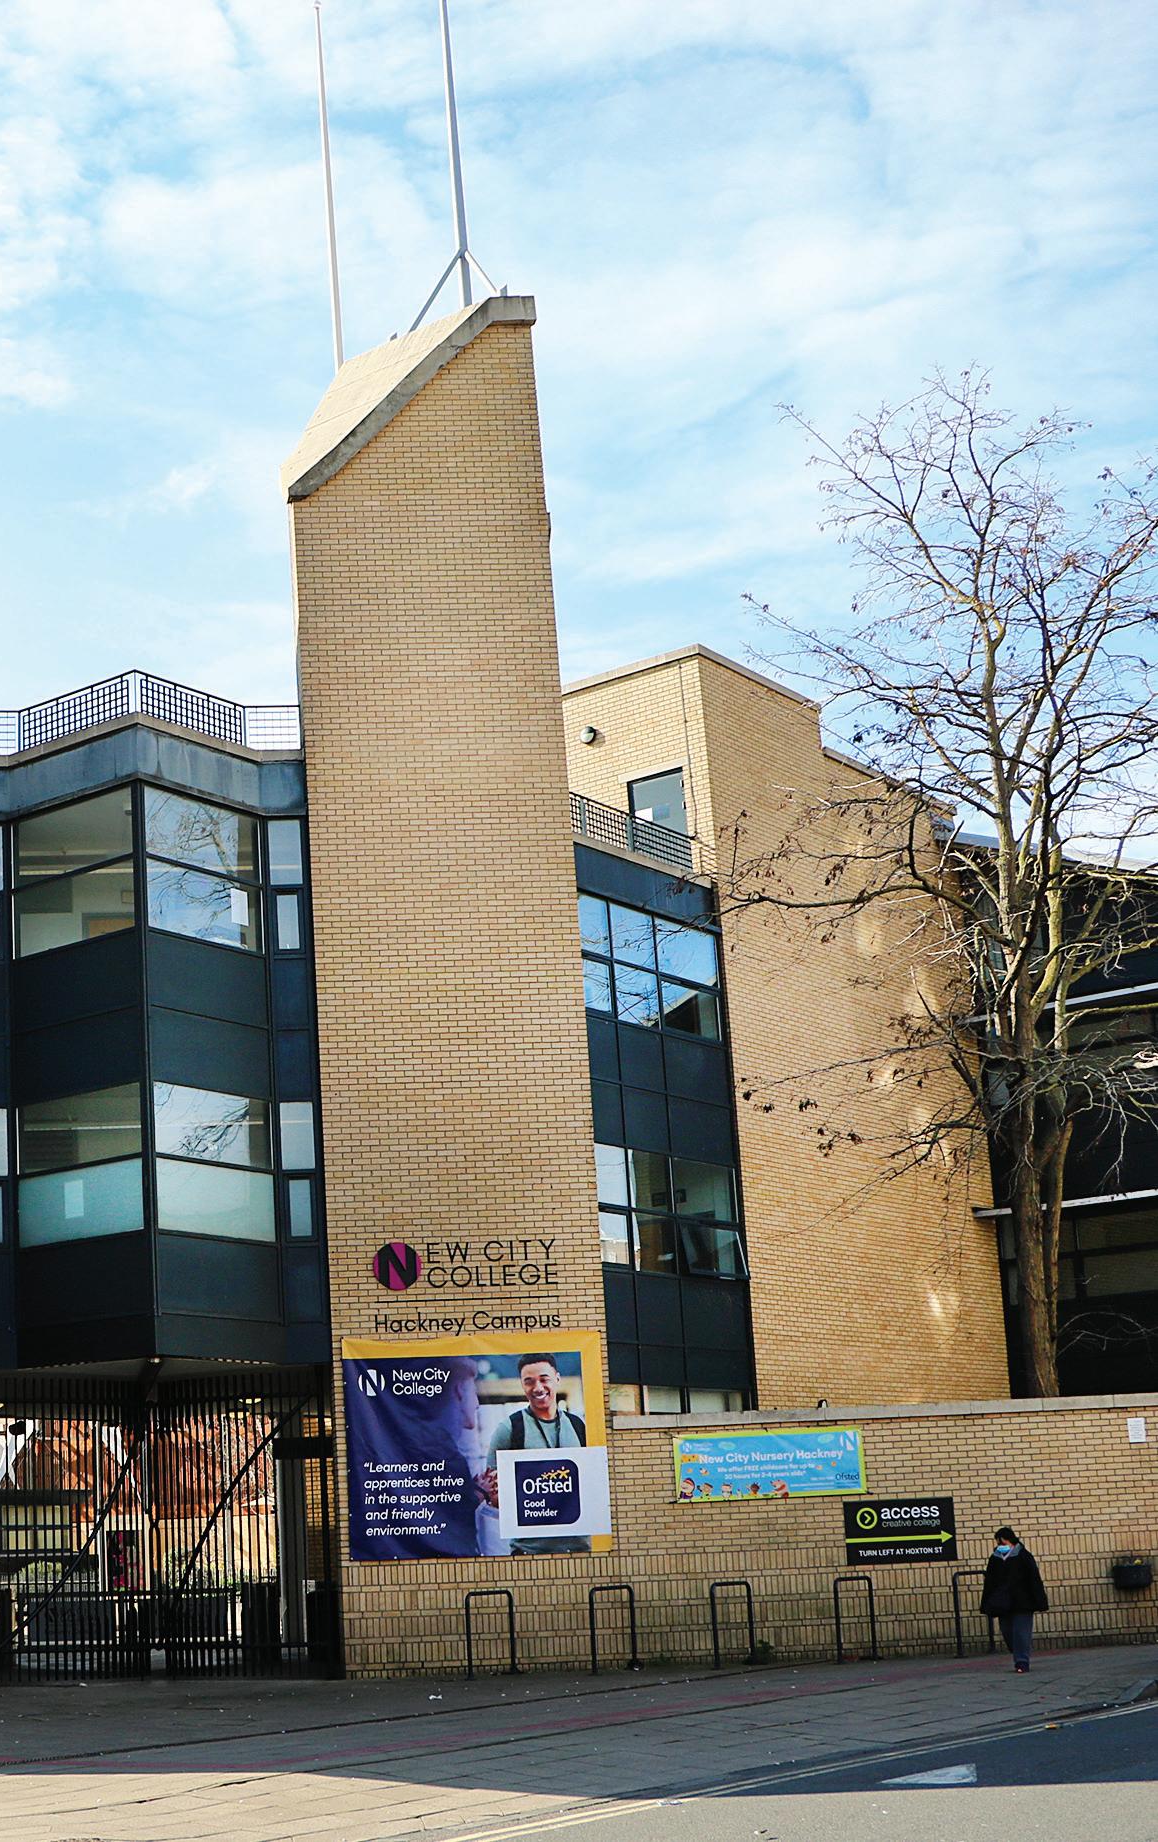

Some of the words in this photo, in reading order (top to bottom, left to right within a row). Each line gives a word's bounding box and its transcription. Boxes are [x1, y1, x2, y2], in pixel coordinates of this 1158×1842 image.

[484, 1238, 556, 1262] CITY
[427, 1263, 559, 1288] COLLEGE
[374, 1312, 466, 1336] Hackney
[472, 1310, 561, 1333] Campus
[392, 1369, 422, 1382] New
[423, 1367, 450, 1381] City
[392, 1383, 443, 1397] College
[699, 1454, 723, 1464] New
[725, 1452, 749, 1464] City
[751, 1450, 795, 1462] Nursery
[796, 1448, 843, 1460] Hackney
[422, 1459, 445, 1472] and
[364, 1477, 430, 1490] apprentices
[432, 1475, 464, 1487] thrive
[523, 1477, 572, 1494] Ofsted
[365, 1493, 375, 1505] in
[378, 1492, 398, 1504] the
[400, 1491, 461, 1506] supportive
[524, 1499, 546, 1508] Good
[365, 1508, 389, 1521] and
[391, 1508, 435, 1522] friendly
[524, 1508, 558, 1518] Provider
[881, 1505, 940, 1519] access
[882, 1519, 912, 1528] creative
[913, 1518, 941, 1527] college
[905, 1547, 933, 1555] HOXTON
